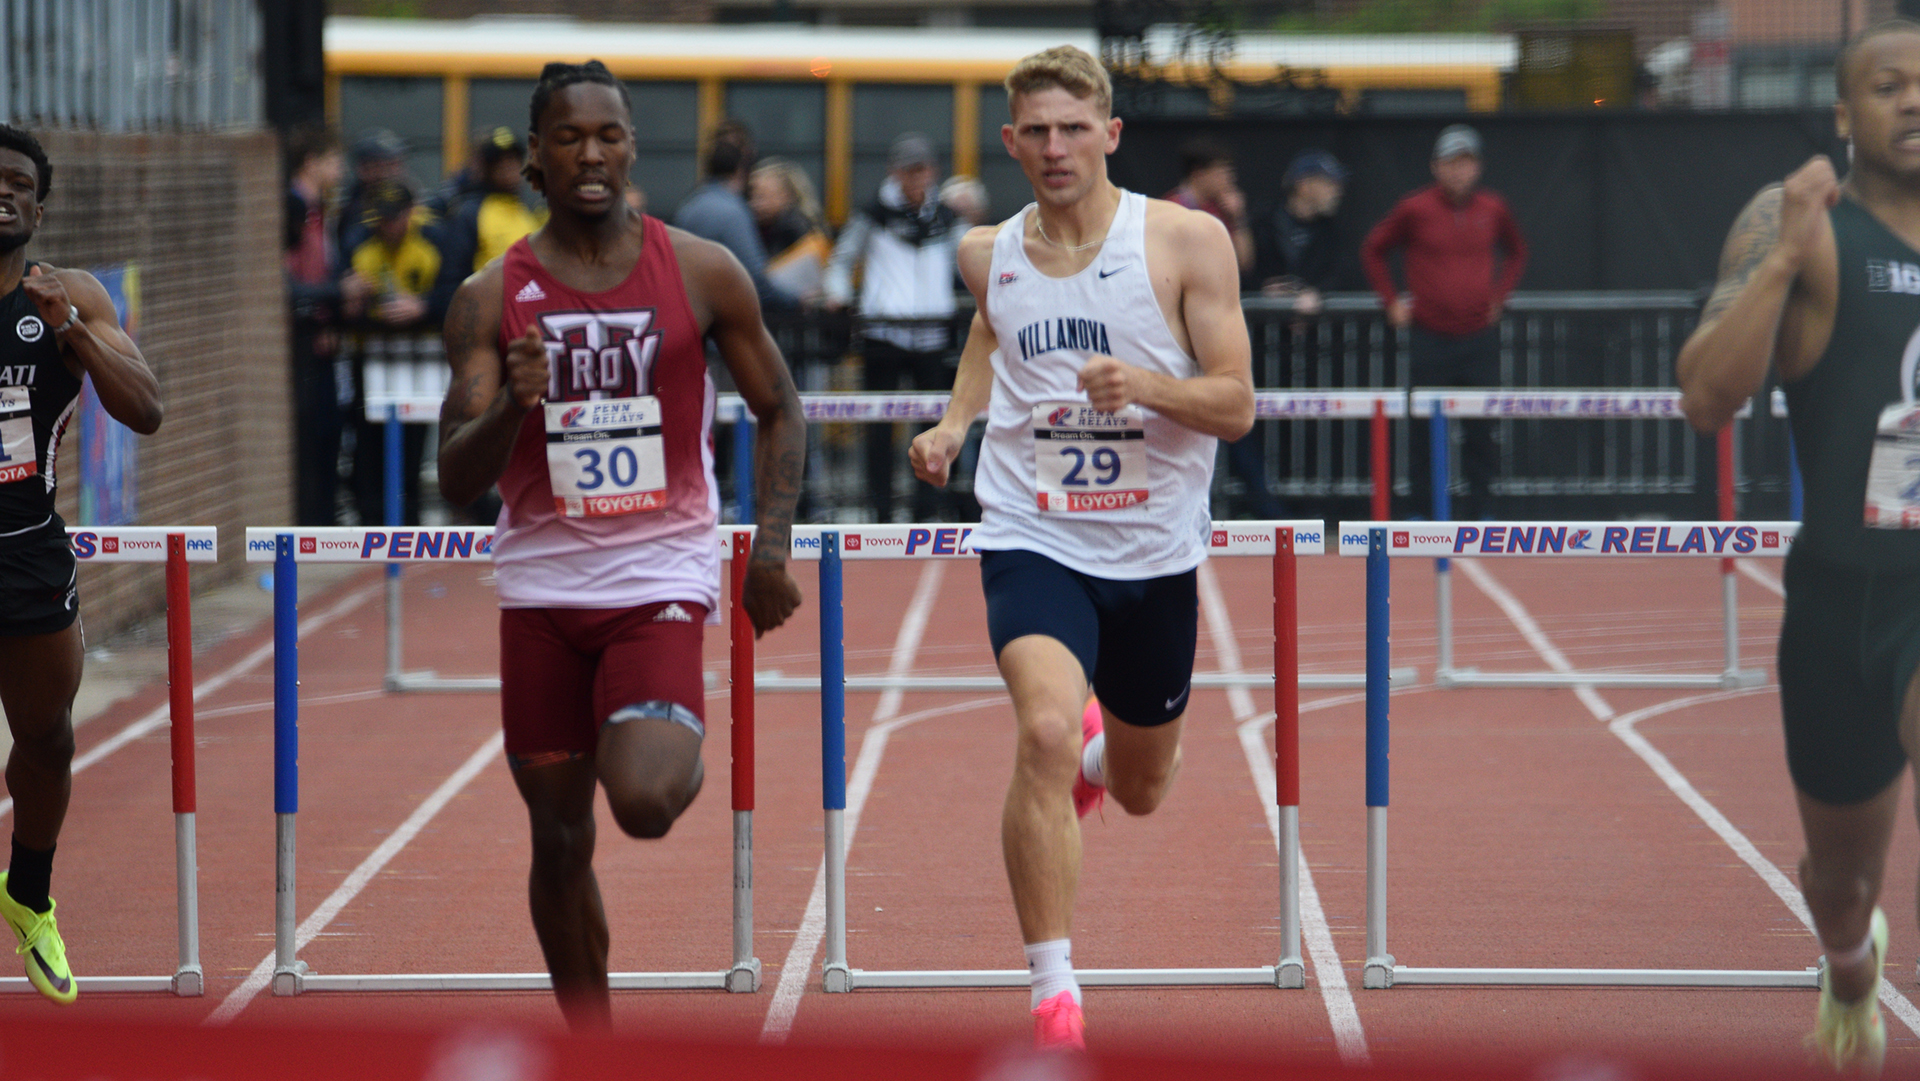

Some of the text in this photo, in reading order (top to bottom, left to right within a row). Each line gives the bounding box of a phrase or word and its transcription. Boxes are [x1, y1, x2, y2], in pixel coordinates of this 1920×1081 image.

[1017, 316, 1113, 361] VILLANOVA
[543, 333, 660, 400] TROY
[593, 403, 632, 413] PENN
[592, 413, 645, 424] RELAYS
[1078, 417, 1128, 426] RELAYS
[575, 445, 638, 490] 30
[1059, 446, 1121, 486] 29
[587, 493, 655, 513] TOYOTA
[1070, 491, 1136, 510] TOYOTA
[122, 540, 162, 550] TOYOTA
[320, 540, 360, 550] TOYOTA
[360, 532, 475, 559] PENN
[864, 538, 904, 547] TOYOTA
[1231, 534, 1271, 544] TOYOTA
[1412, 535, 1452, 545] TOYOTA
[1453, 526, 1568, 554] PENN
[1600, 526, 1758, 554] RELAYS
